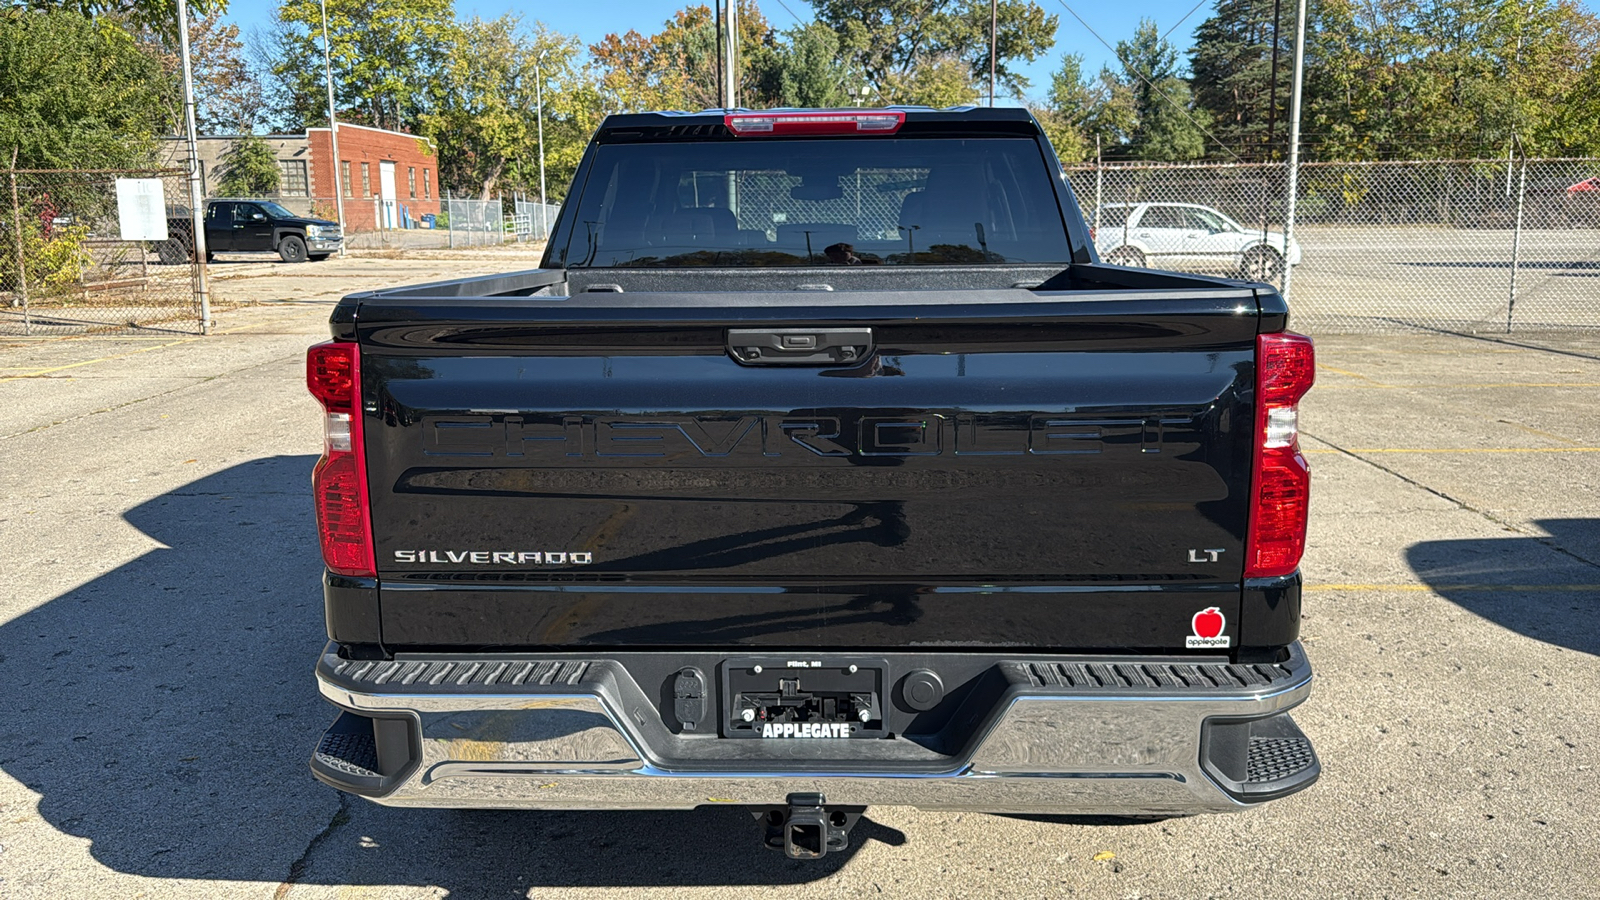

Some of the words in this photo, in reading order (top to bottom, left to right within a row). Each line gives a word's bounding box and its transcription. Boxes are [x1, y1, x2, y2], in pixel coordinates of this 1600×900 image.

[422, 413, 1194, 457] CHEVROLET
[394, 550, 593, 564] SILVERADO
[1188, 548, 1226, 563] LT
[1187, 638, 1228, 646] applegate
[762, 723, 850, 738] APPLEGATE
